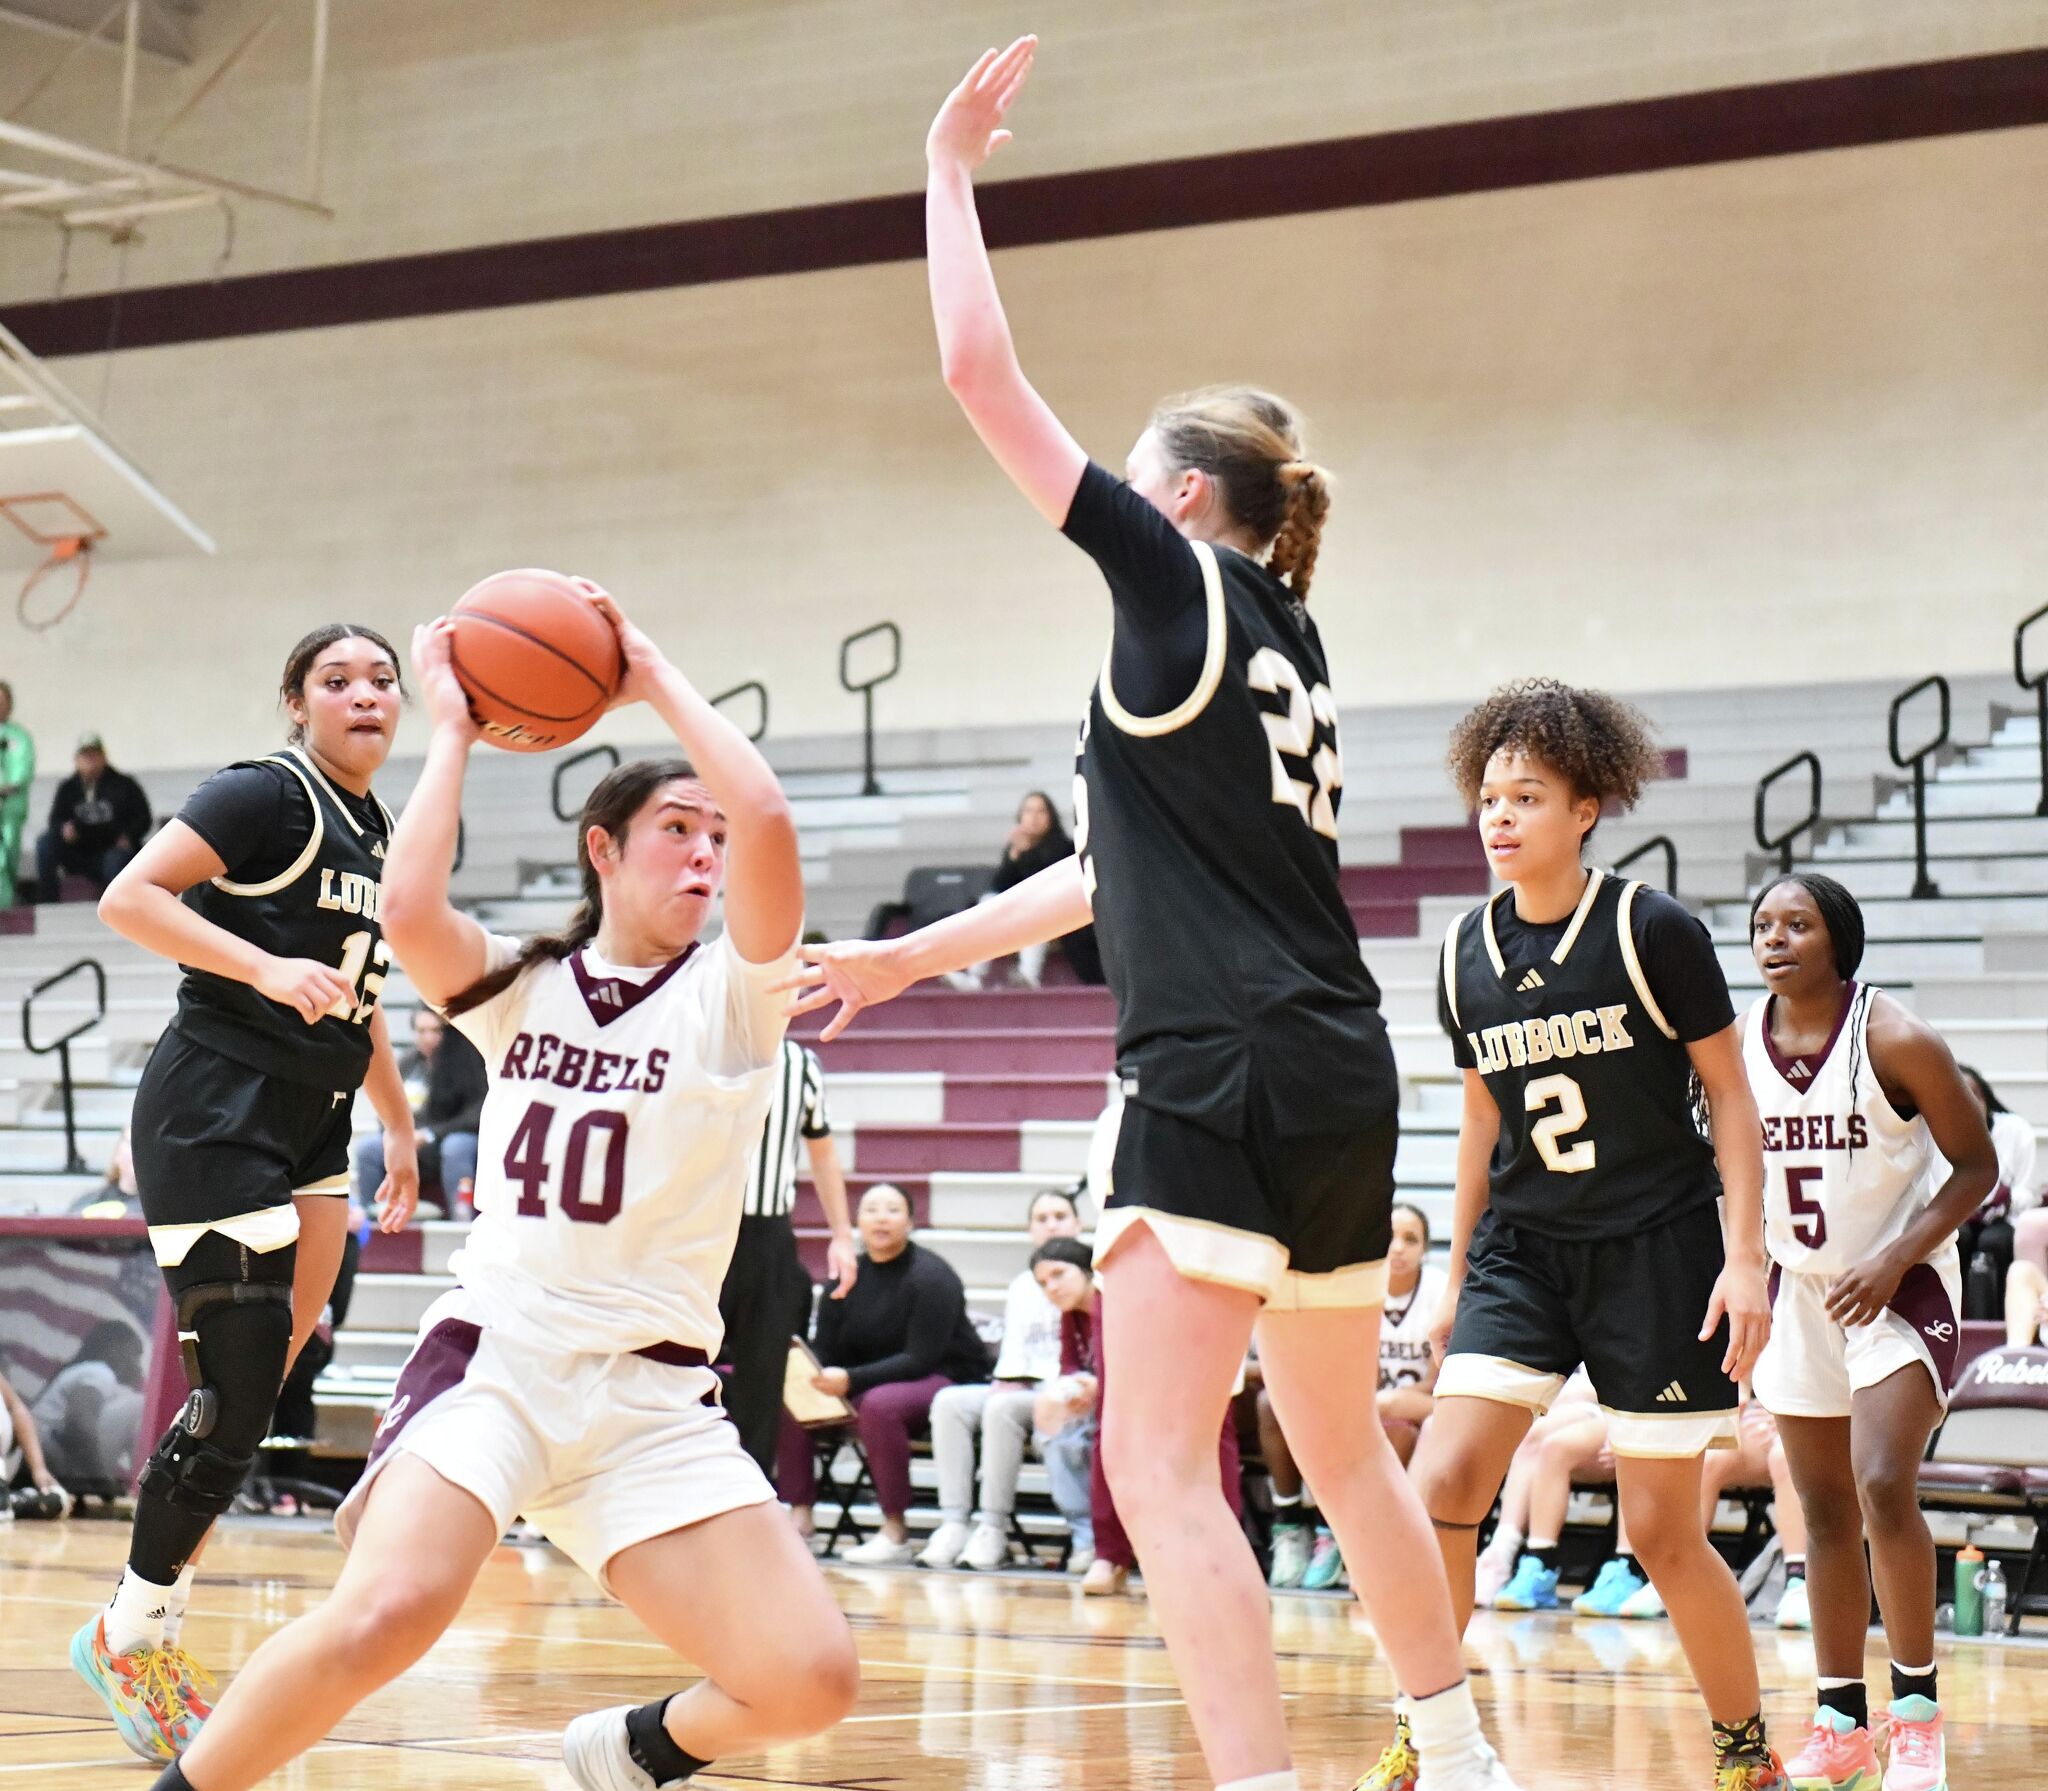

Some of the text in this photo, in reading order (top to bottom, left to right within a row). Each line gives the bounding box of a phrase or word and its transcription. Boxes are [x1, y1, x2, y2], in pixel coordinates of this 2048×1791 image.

[1247, 646, 1344, 839] 22
[317, 868, 384, 925] LUB
[500, 1032, 670, 1093] REBELS
[1467, 1004, 1634, 1075] LUBBOCK
[1524, 1073, 1596, 1173] 2
[1761, 1114, 1869, 1152] EBELS
[503, 1101, 630, 1225] 40
[1785, 1167, 1827, 1250] 5
